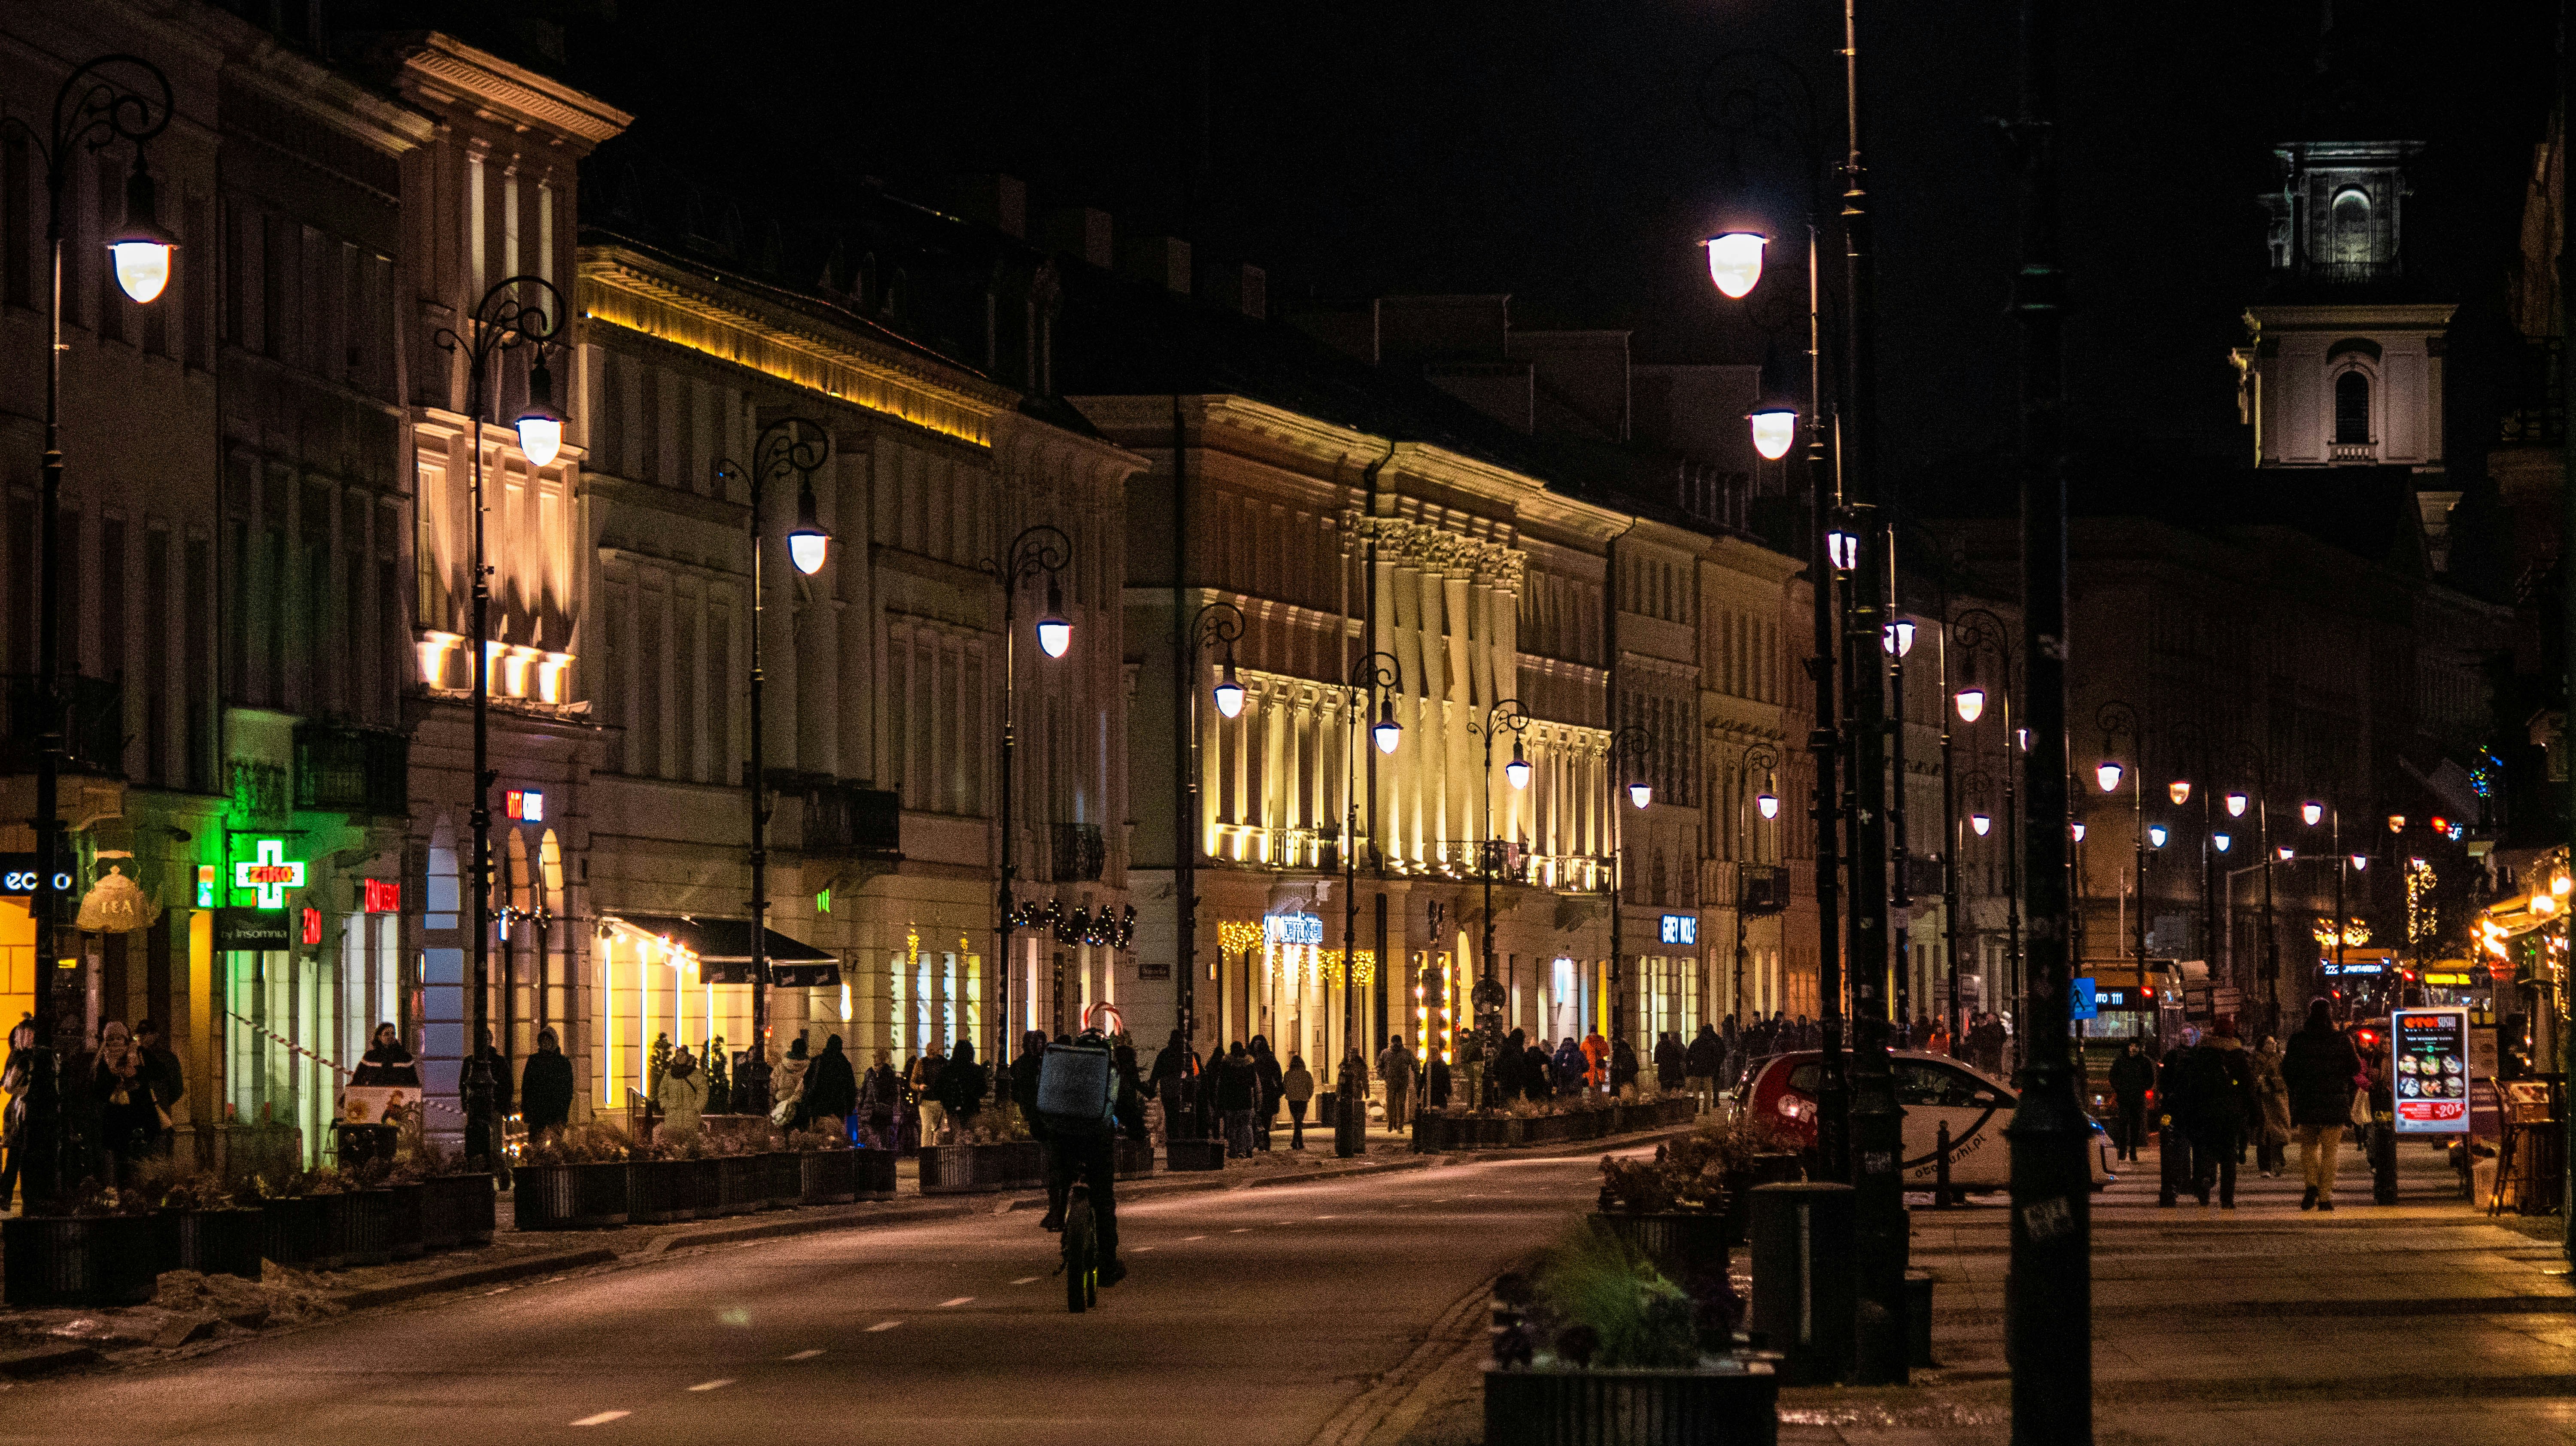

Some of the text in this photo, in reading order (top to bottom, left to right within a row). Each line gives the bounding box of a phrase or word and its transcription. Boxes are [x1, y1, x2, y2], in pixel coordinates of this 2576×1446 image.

[4, 872, 72, 890] eco
[101, 900, 134, 915] TEA
[1663, 915, 1696, 944] GREY WOLF
[1915, 1133, 1987, 1179] otoushi.pl
